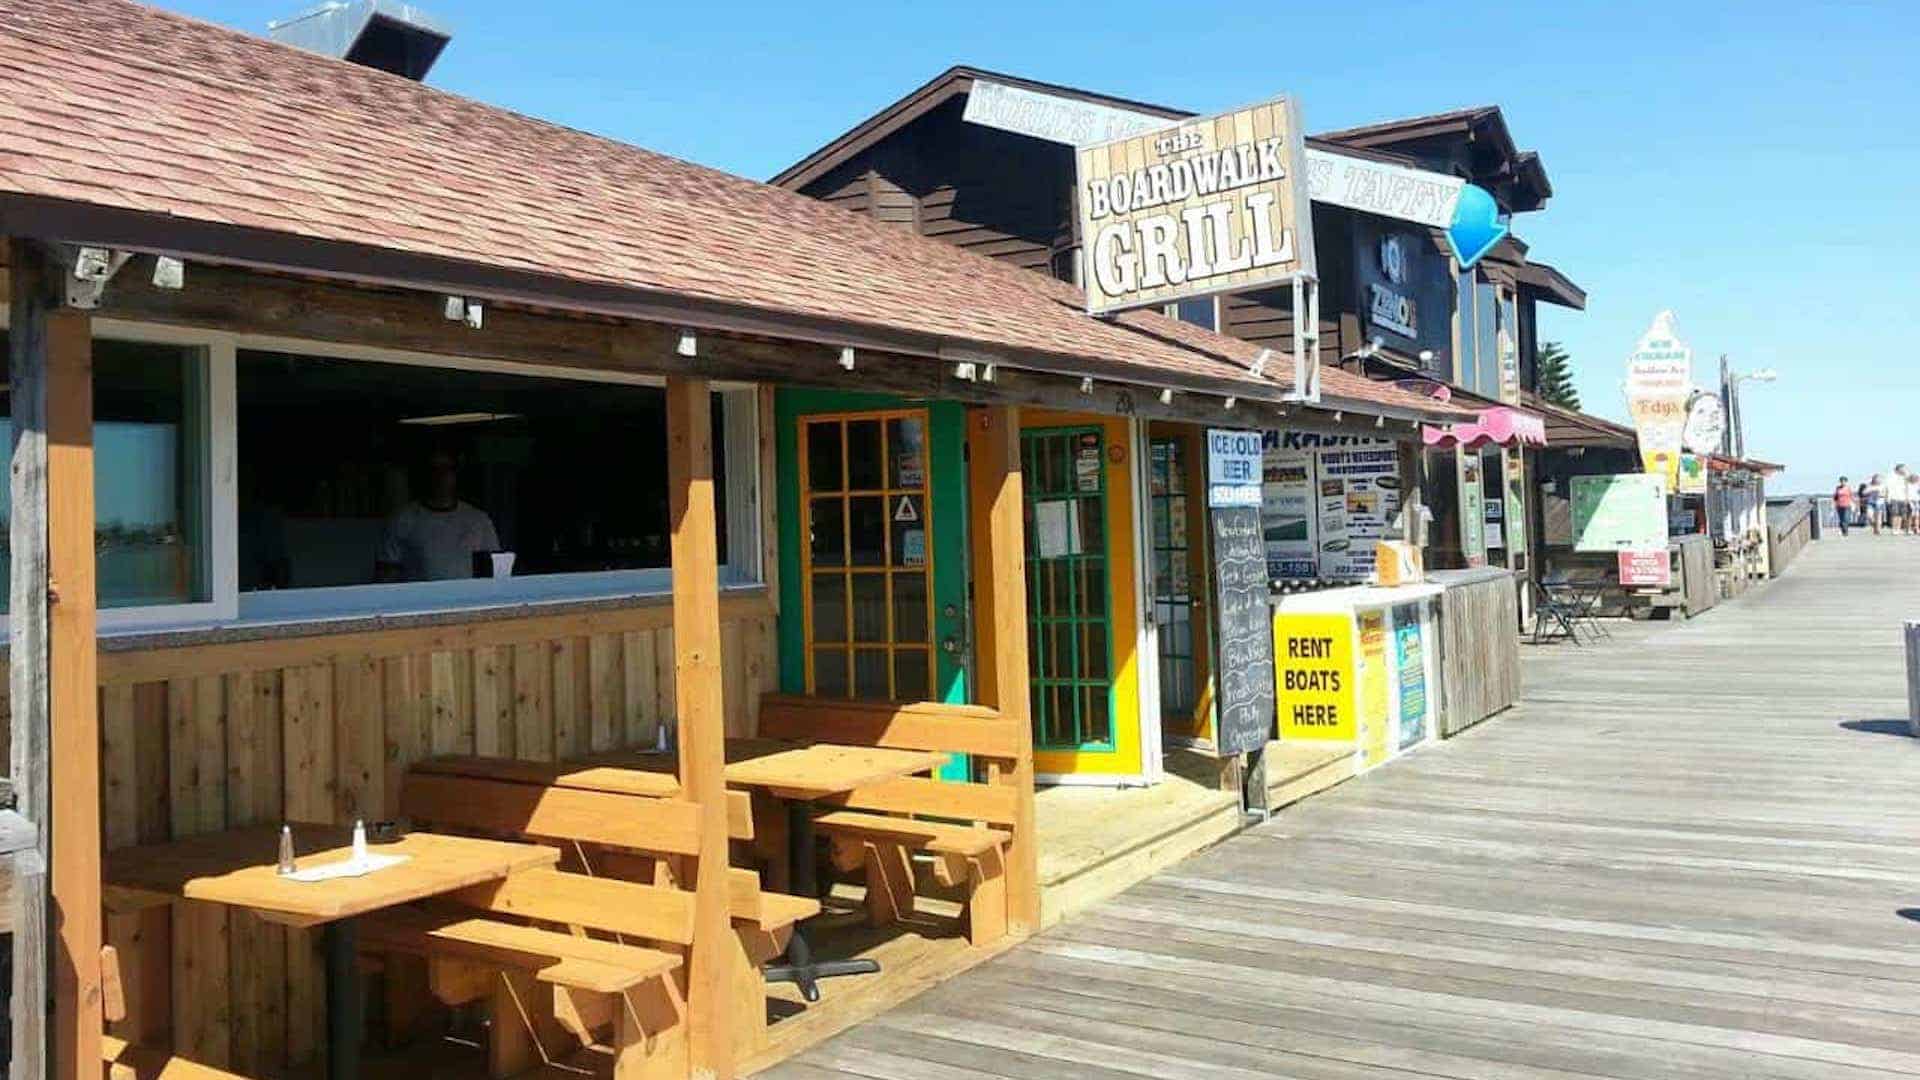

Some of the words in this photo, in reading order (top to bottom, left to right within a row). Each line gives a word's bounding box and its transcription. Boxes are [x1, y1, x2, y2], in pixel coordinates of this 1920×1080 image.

[1155, 133, 1204, 157] THE
[1089, 137, 1285, 220] BOARDWALK
[1094, 192, 1296, 297] GRILL
[1211, 434, 1229, 454] ICE
[1288, 637, 1333, 659] RENT
[1285, 669, 1341, 692] BOATS
[1293, 704, 1338, 727] HERE
